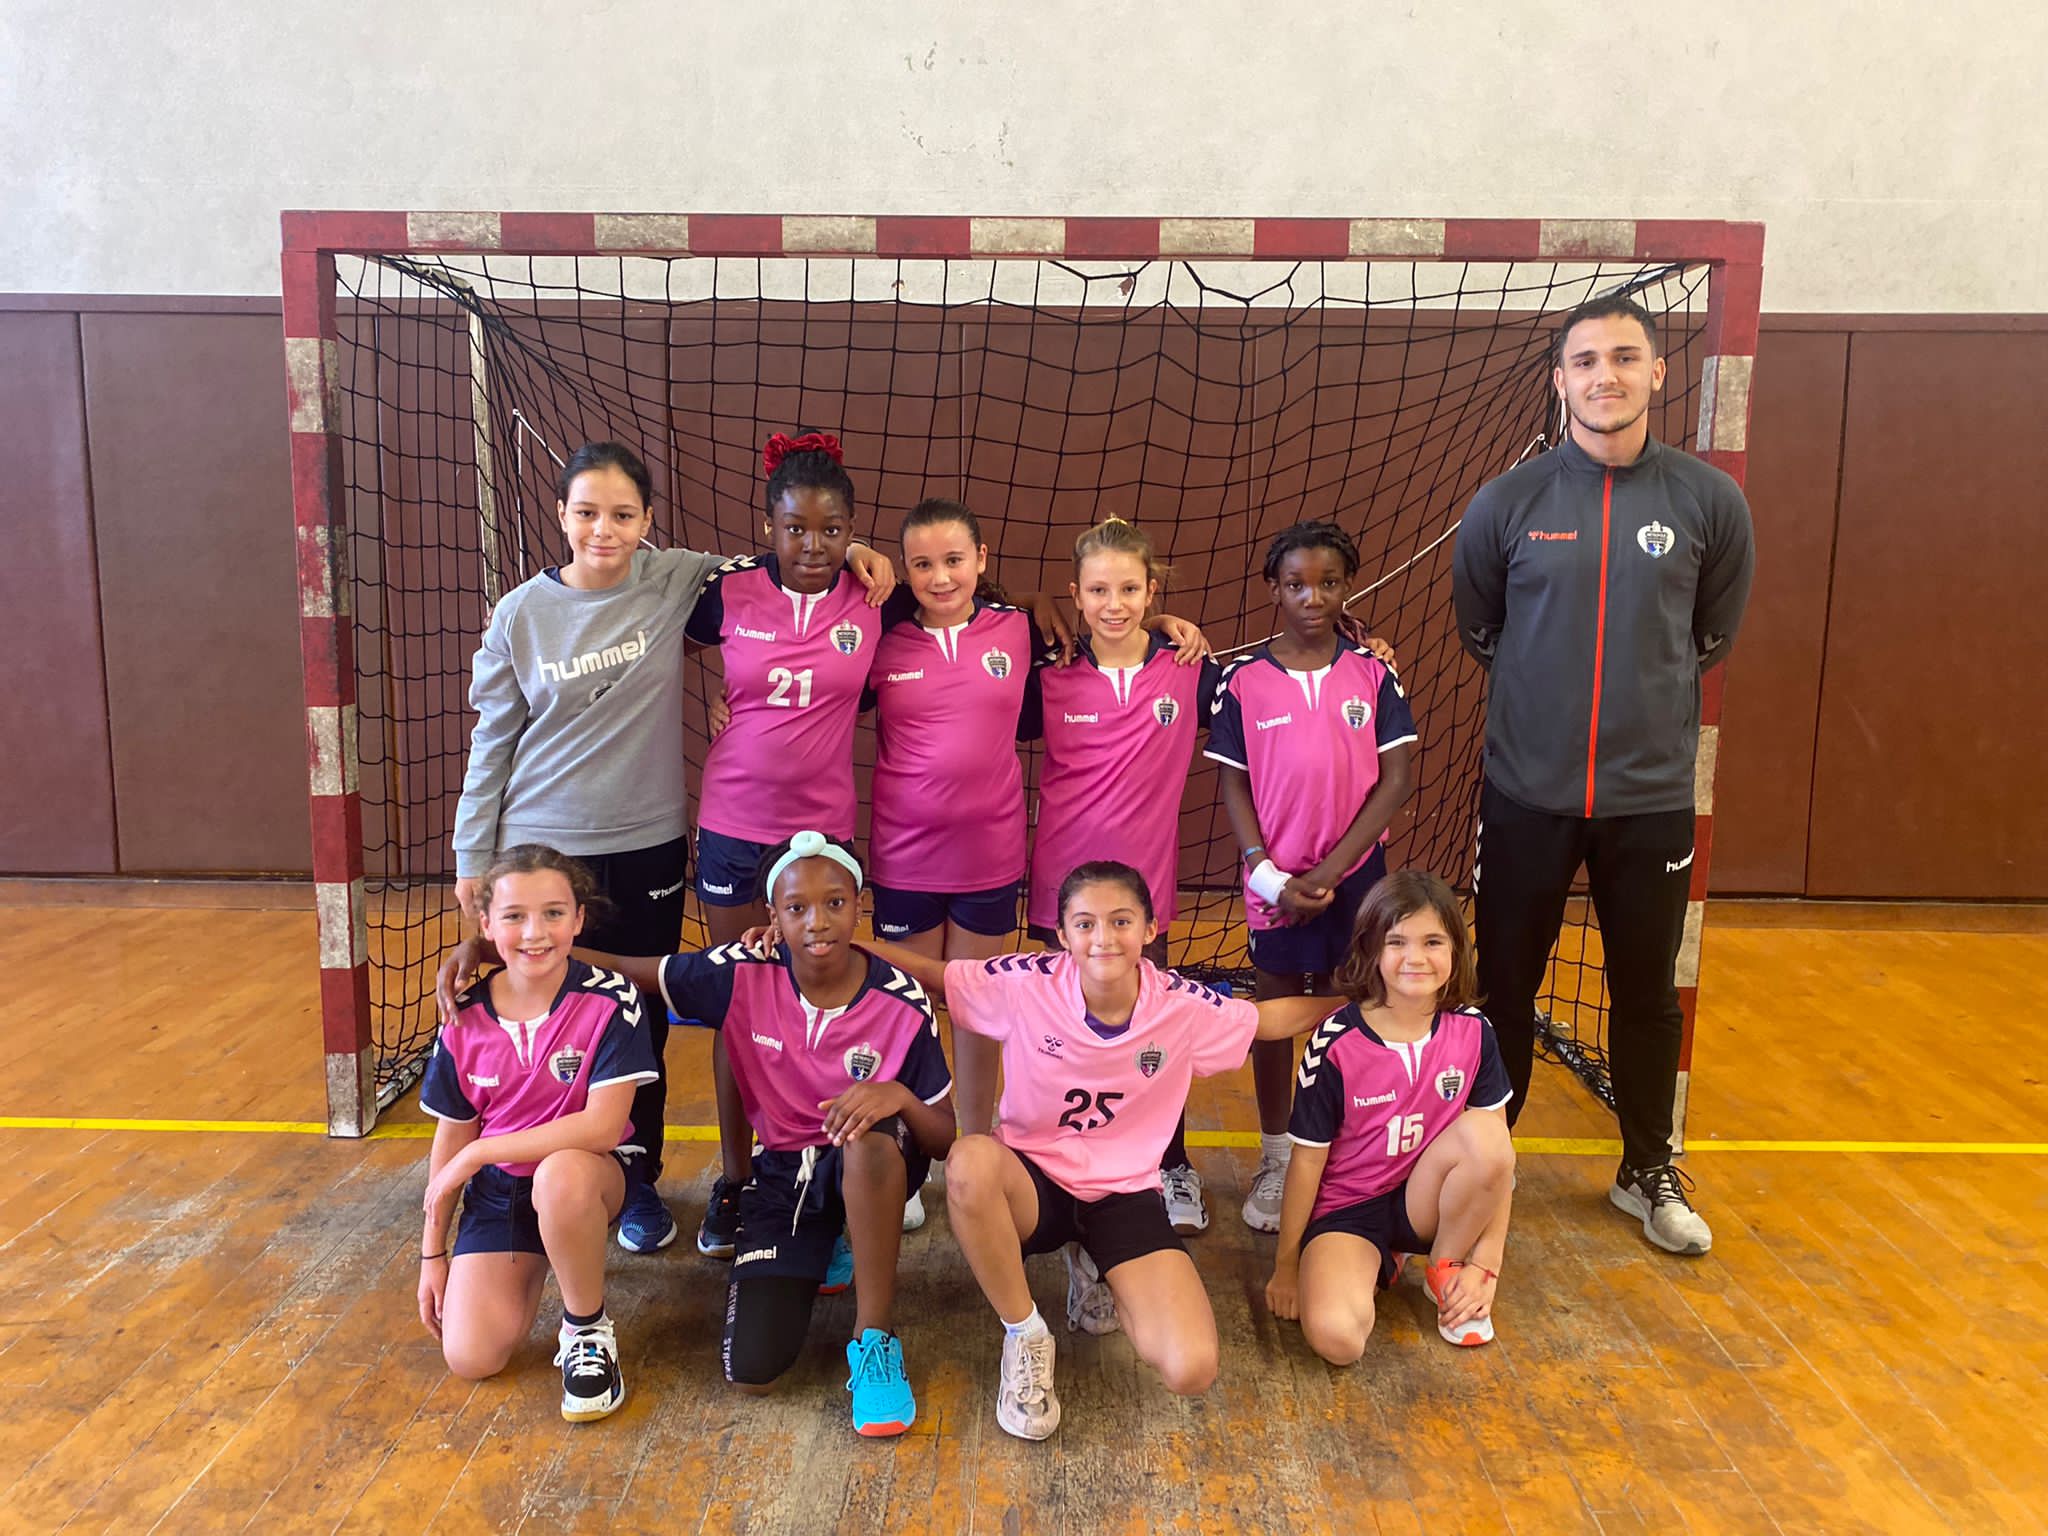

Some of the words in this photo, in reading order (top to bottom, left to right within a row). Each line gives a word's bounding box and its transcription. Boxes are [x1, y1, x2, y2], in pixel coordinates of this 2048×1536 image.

[735, 624, 776, 641] hummel
[537, 631, 646, 684] hummel
[887, 668, 924, 682] hummel
[766, 666, 814, 708] 21
[1064, 712, 1098, 723] hummel
[1256, 711, 1292, 730] hummel
[1353, 1089, 1397, 1108] hummel
[1057, 1088, 1124, 1132] 25
[1386, 1112, 1424, 1157] 15
